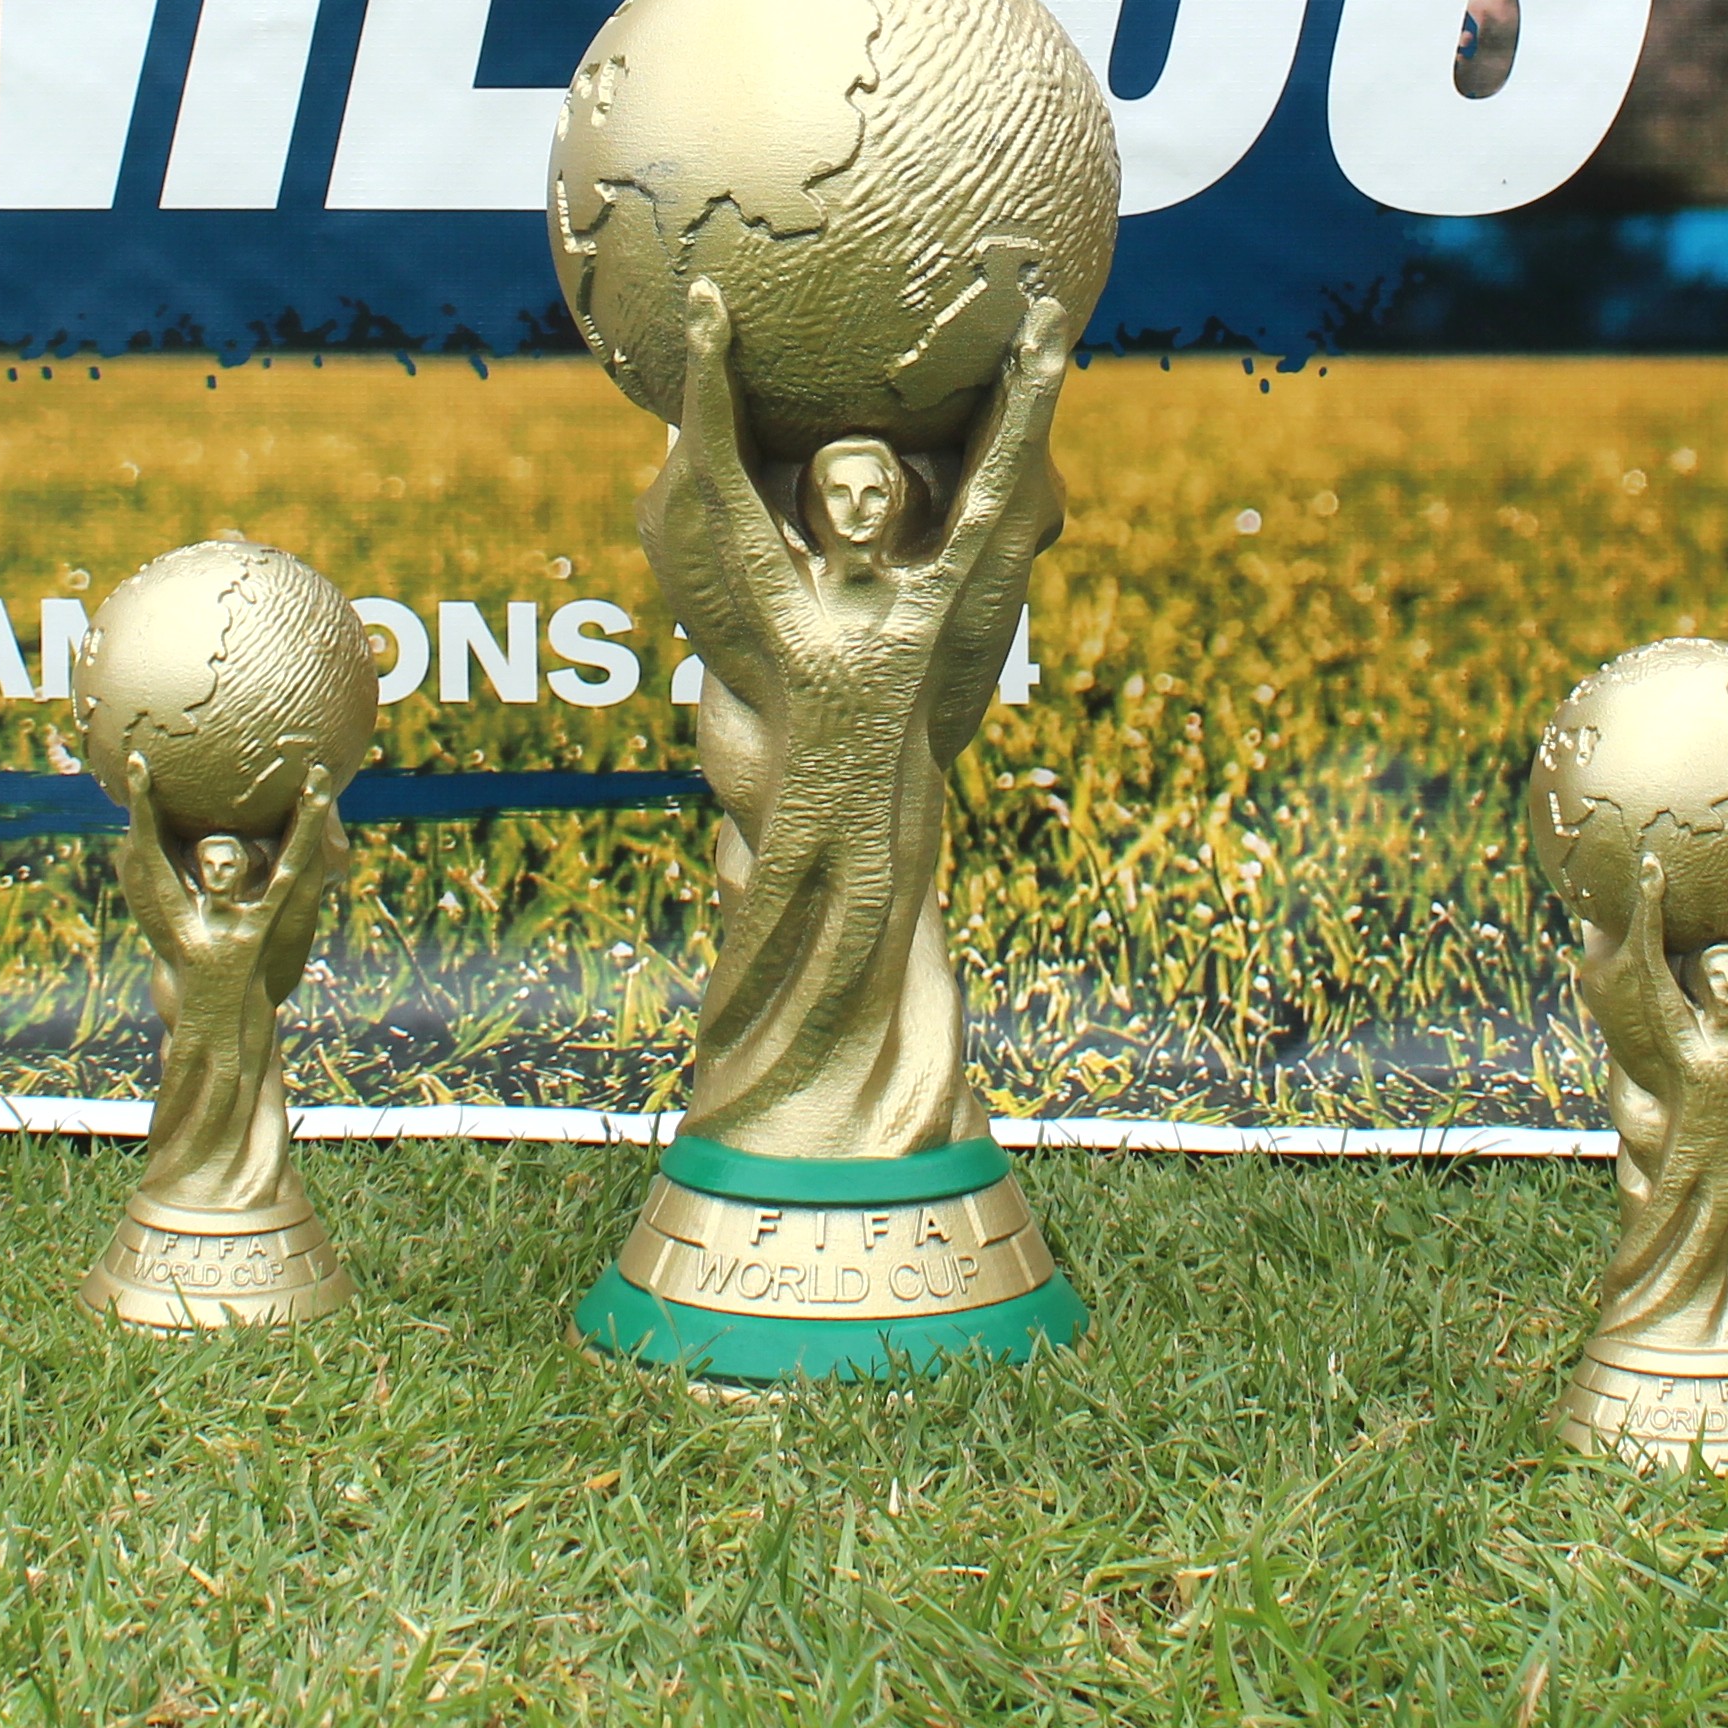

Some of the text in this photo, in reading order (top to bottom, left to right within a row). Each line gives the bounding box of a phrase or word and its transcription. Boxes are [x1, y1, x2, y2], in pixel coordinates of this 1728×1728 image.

[749, 1206, 952, 1250] FIFA
[161, 1233, 268, 1259] FIFA
[133, 1253, 285, 1287] WORLD CUP
[693, 1246, 981, 1304] WORLD CUP
[1624, 1401, 1728, 1433] WORLD
